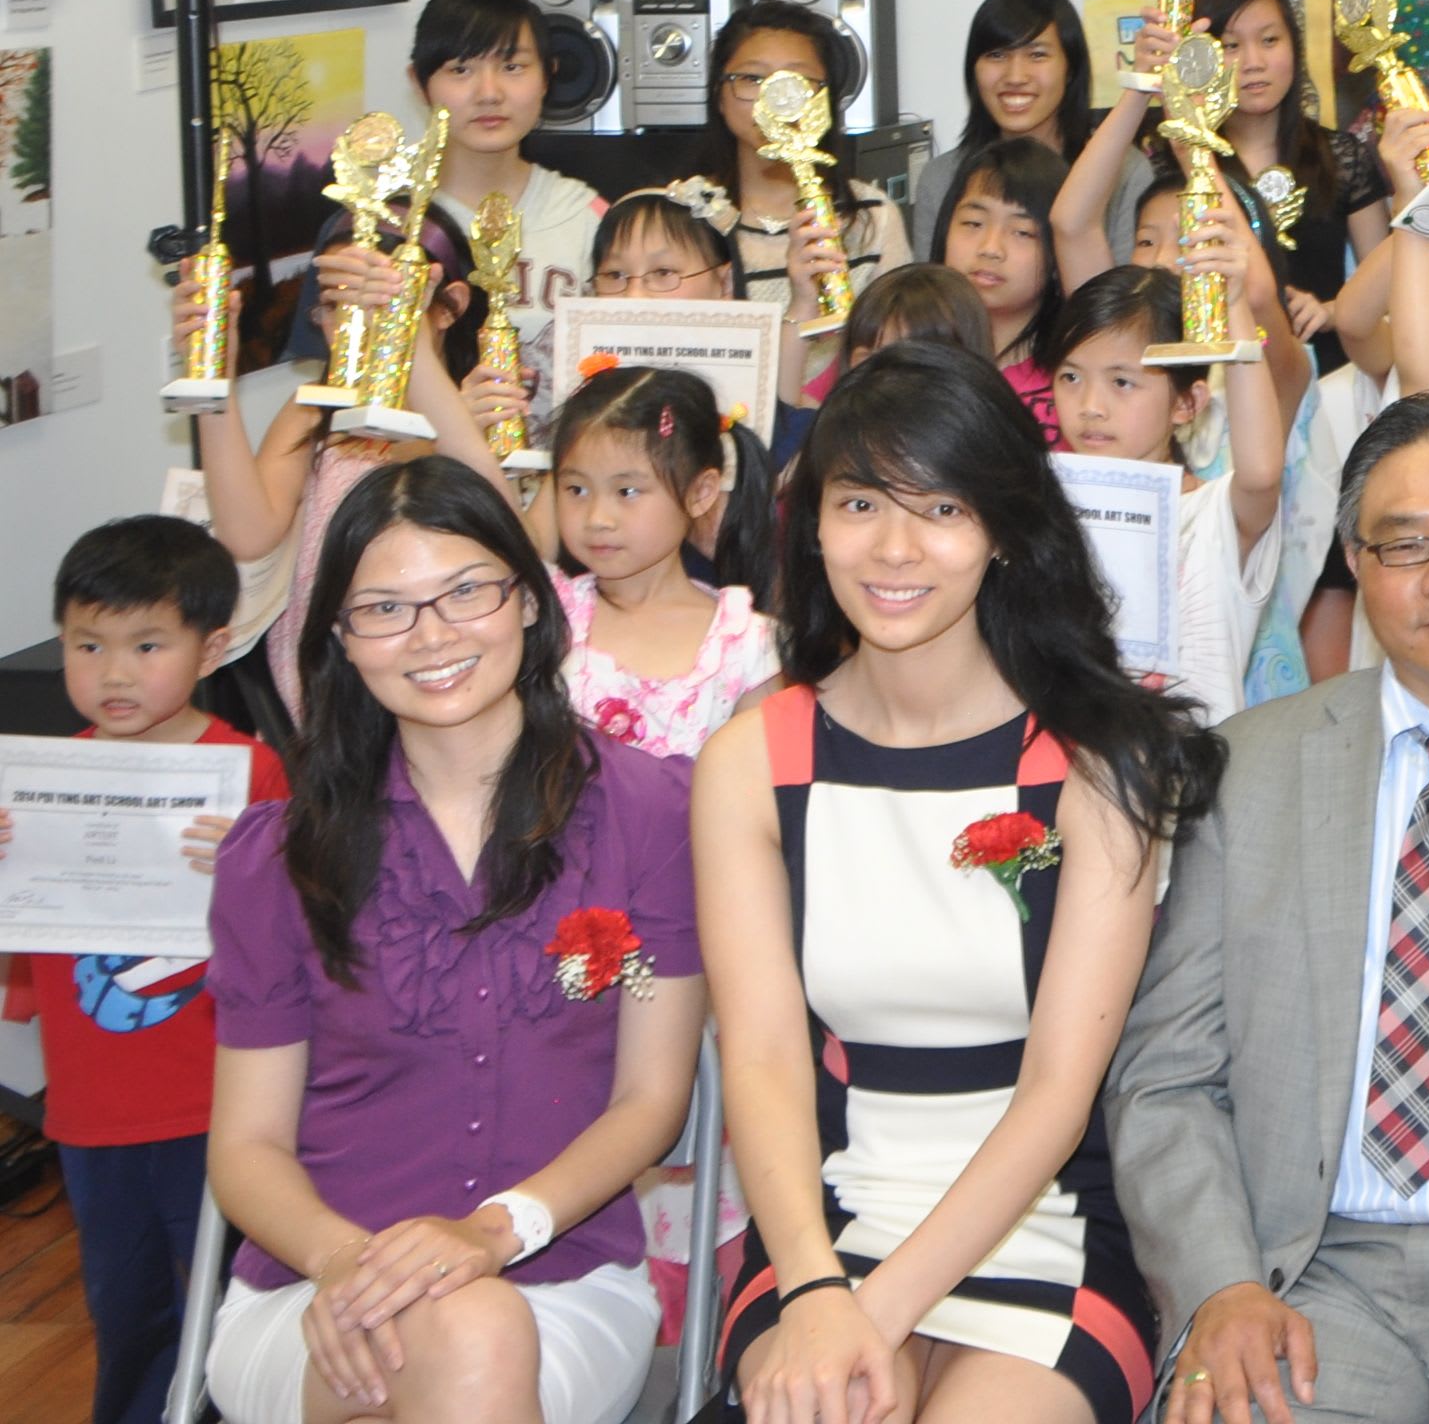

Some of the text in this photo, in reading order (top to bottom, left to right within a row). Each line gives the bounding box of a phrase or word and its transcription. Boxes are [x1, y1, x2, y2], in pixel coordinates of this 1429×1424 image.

[616, 346, 632, 357] PUI
[634, 347, 654, 357] YING
[656, 347, 673, 357] ART
[675, 347, 708, 358] SCHOOL
[710, 348, 726, 358] ART
[728, 349, 753, 359] SHOW
[1104, 510, 1122, 522] ART
[1124, 512, 1152, 525] SHOW
[13, 790, 36, 803] 2014
[104, 795, 144, 808] SCHOOL
